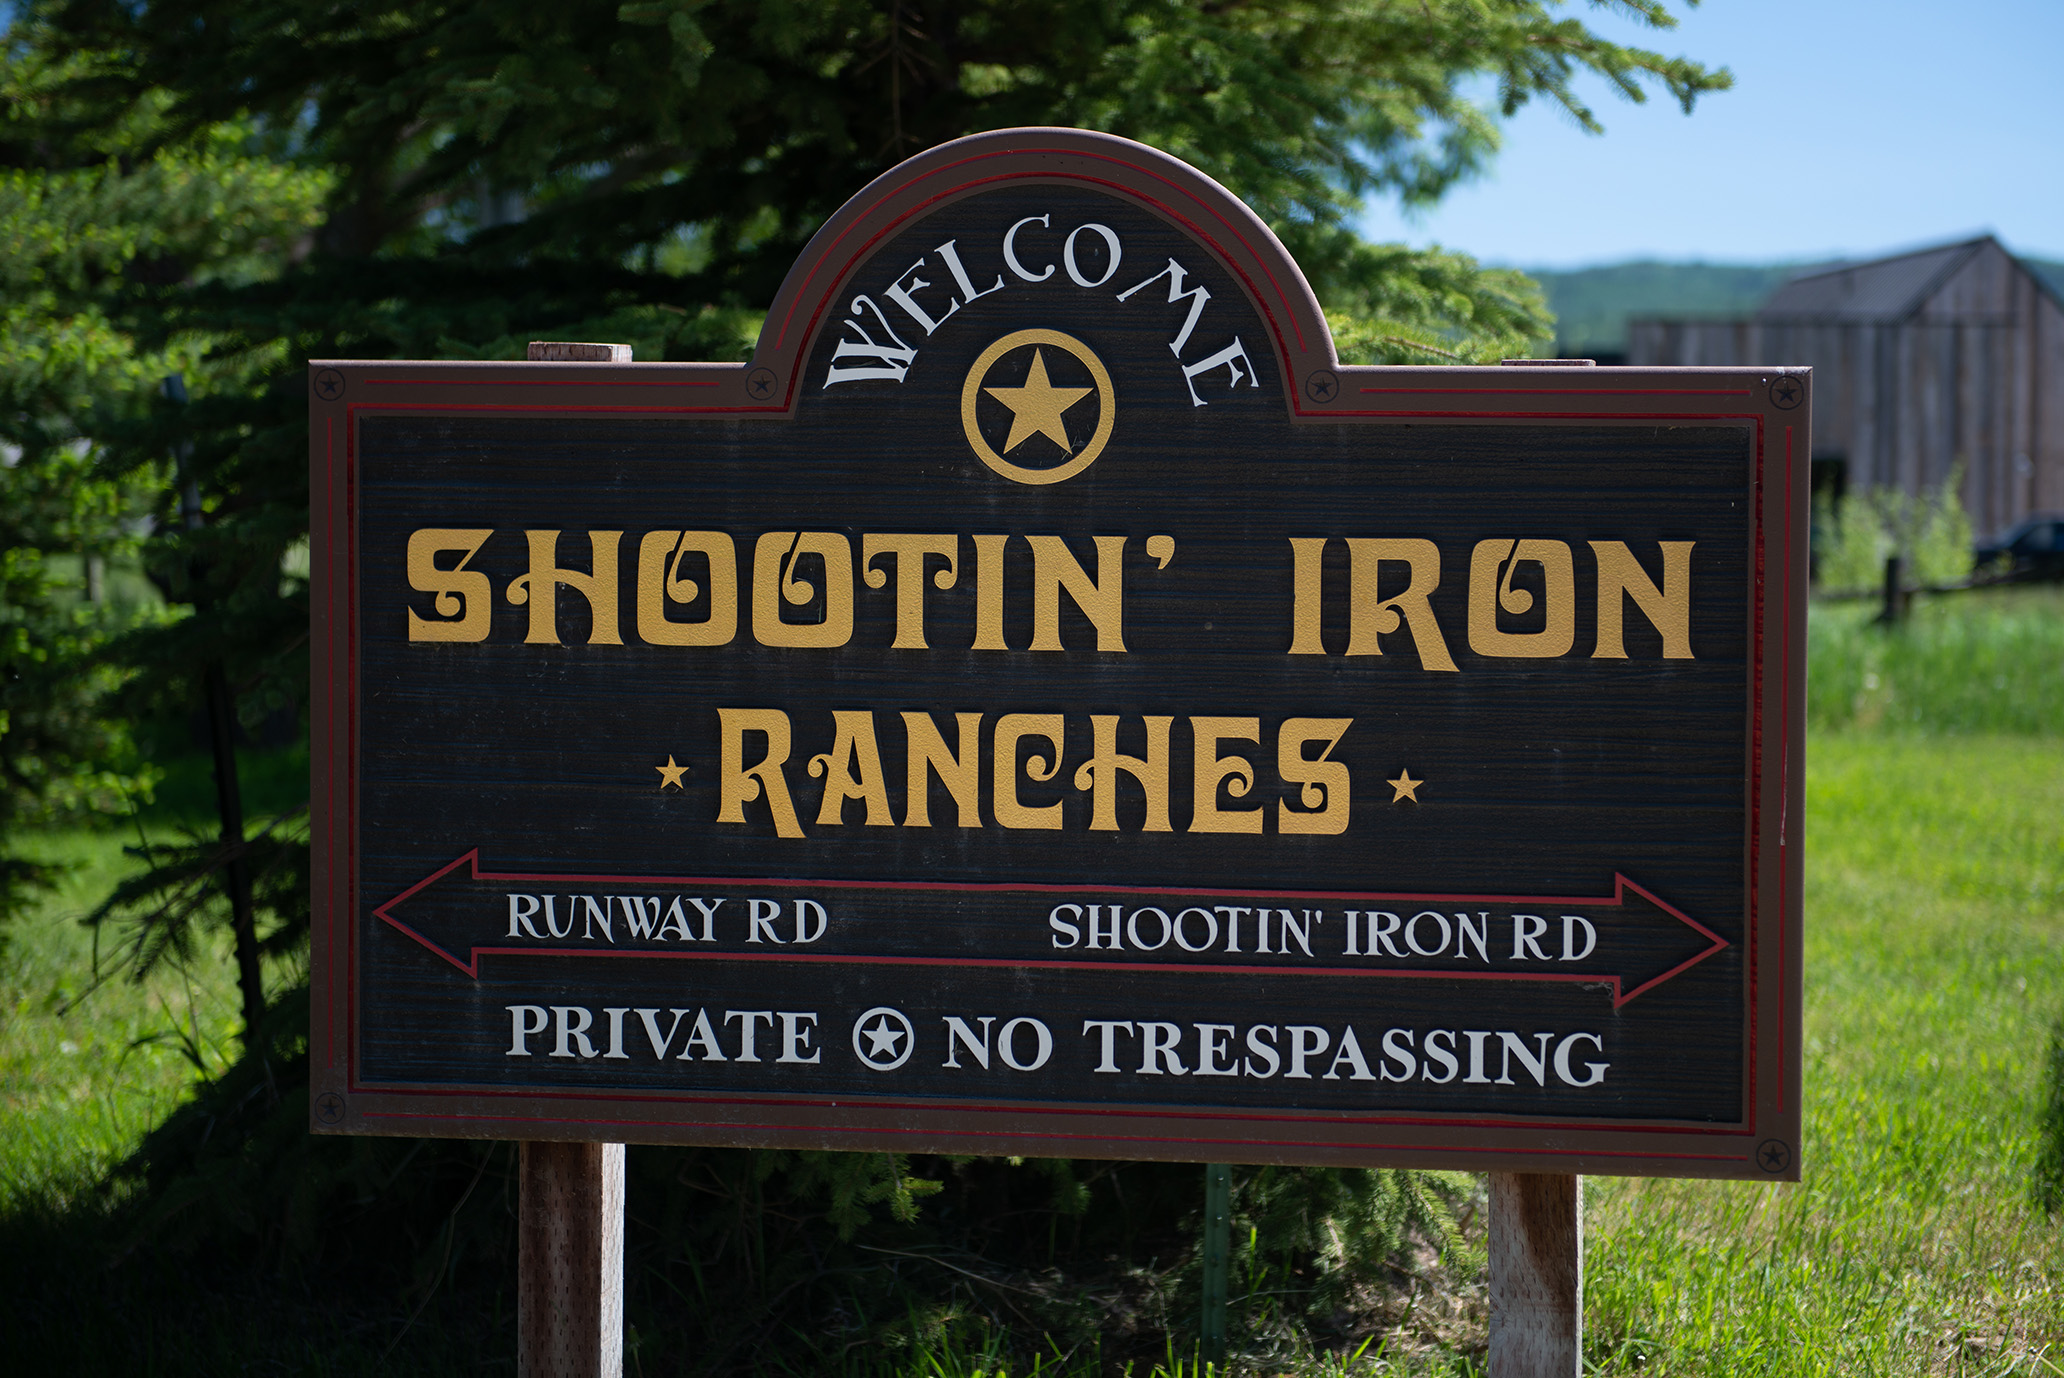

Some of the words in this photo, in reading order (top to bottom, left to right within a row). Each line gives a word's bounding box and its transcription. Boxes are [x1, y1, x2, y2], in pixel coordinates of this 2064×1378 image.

[823, 213, 1260, 408] WELCOME
[408, 529, 1174, 652] SHOOTIN'
[1288, 538, 1695, 671] IRON
[717, 709, 1353, 837] RANCHES
[506, 895, 726, 943] RUNWAY
[746, 900, 827, 943] RD
[1050, 904, 1322, 957] SHOOTIN'
[1343, 911, 1489, 963] IRON
[1510, 915, 1596, 960] RD
[506, 1006, 820, 1063] PRIVATE
[942, 1017, 1052, 1070] NO
[1083, 1021, 1610, 1086] TRESPASSING
